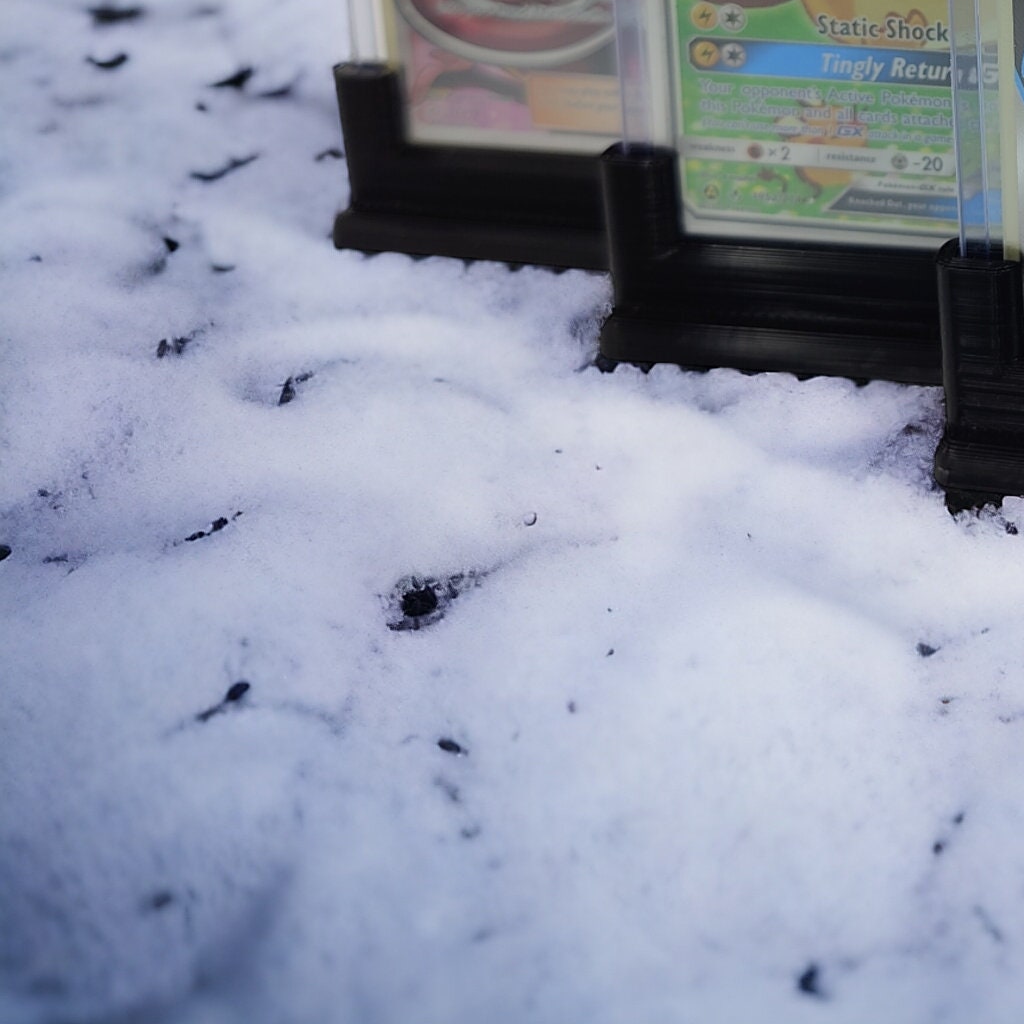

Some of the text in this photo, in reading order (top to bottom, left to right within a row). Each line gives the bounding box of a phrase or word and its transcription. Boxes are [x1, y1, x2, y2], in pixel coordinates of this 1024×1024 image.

[818, 14, 949, 43] Static Shock
[822, 52, 885, 81] Tingly
[699, 78, 732, 94] Your
[741, 85, 822, 101] opponent's
[827, 87, 874, 104] Active
[881, 89, 951, 109] Pokémon
[731, 99, 799, 118] Pokémon
[806, 105, 831, 120] and
[837, 107, 853, 121] all
[859, 109, 898, 125] cards
